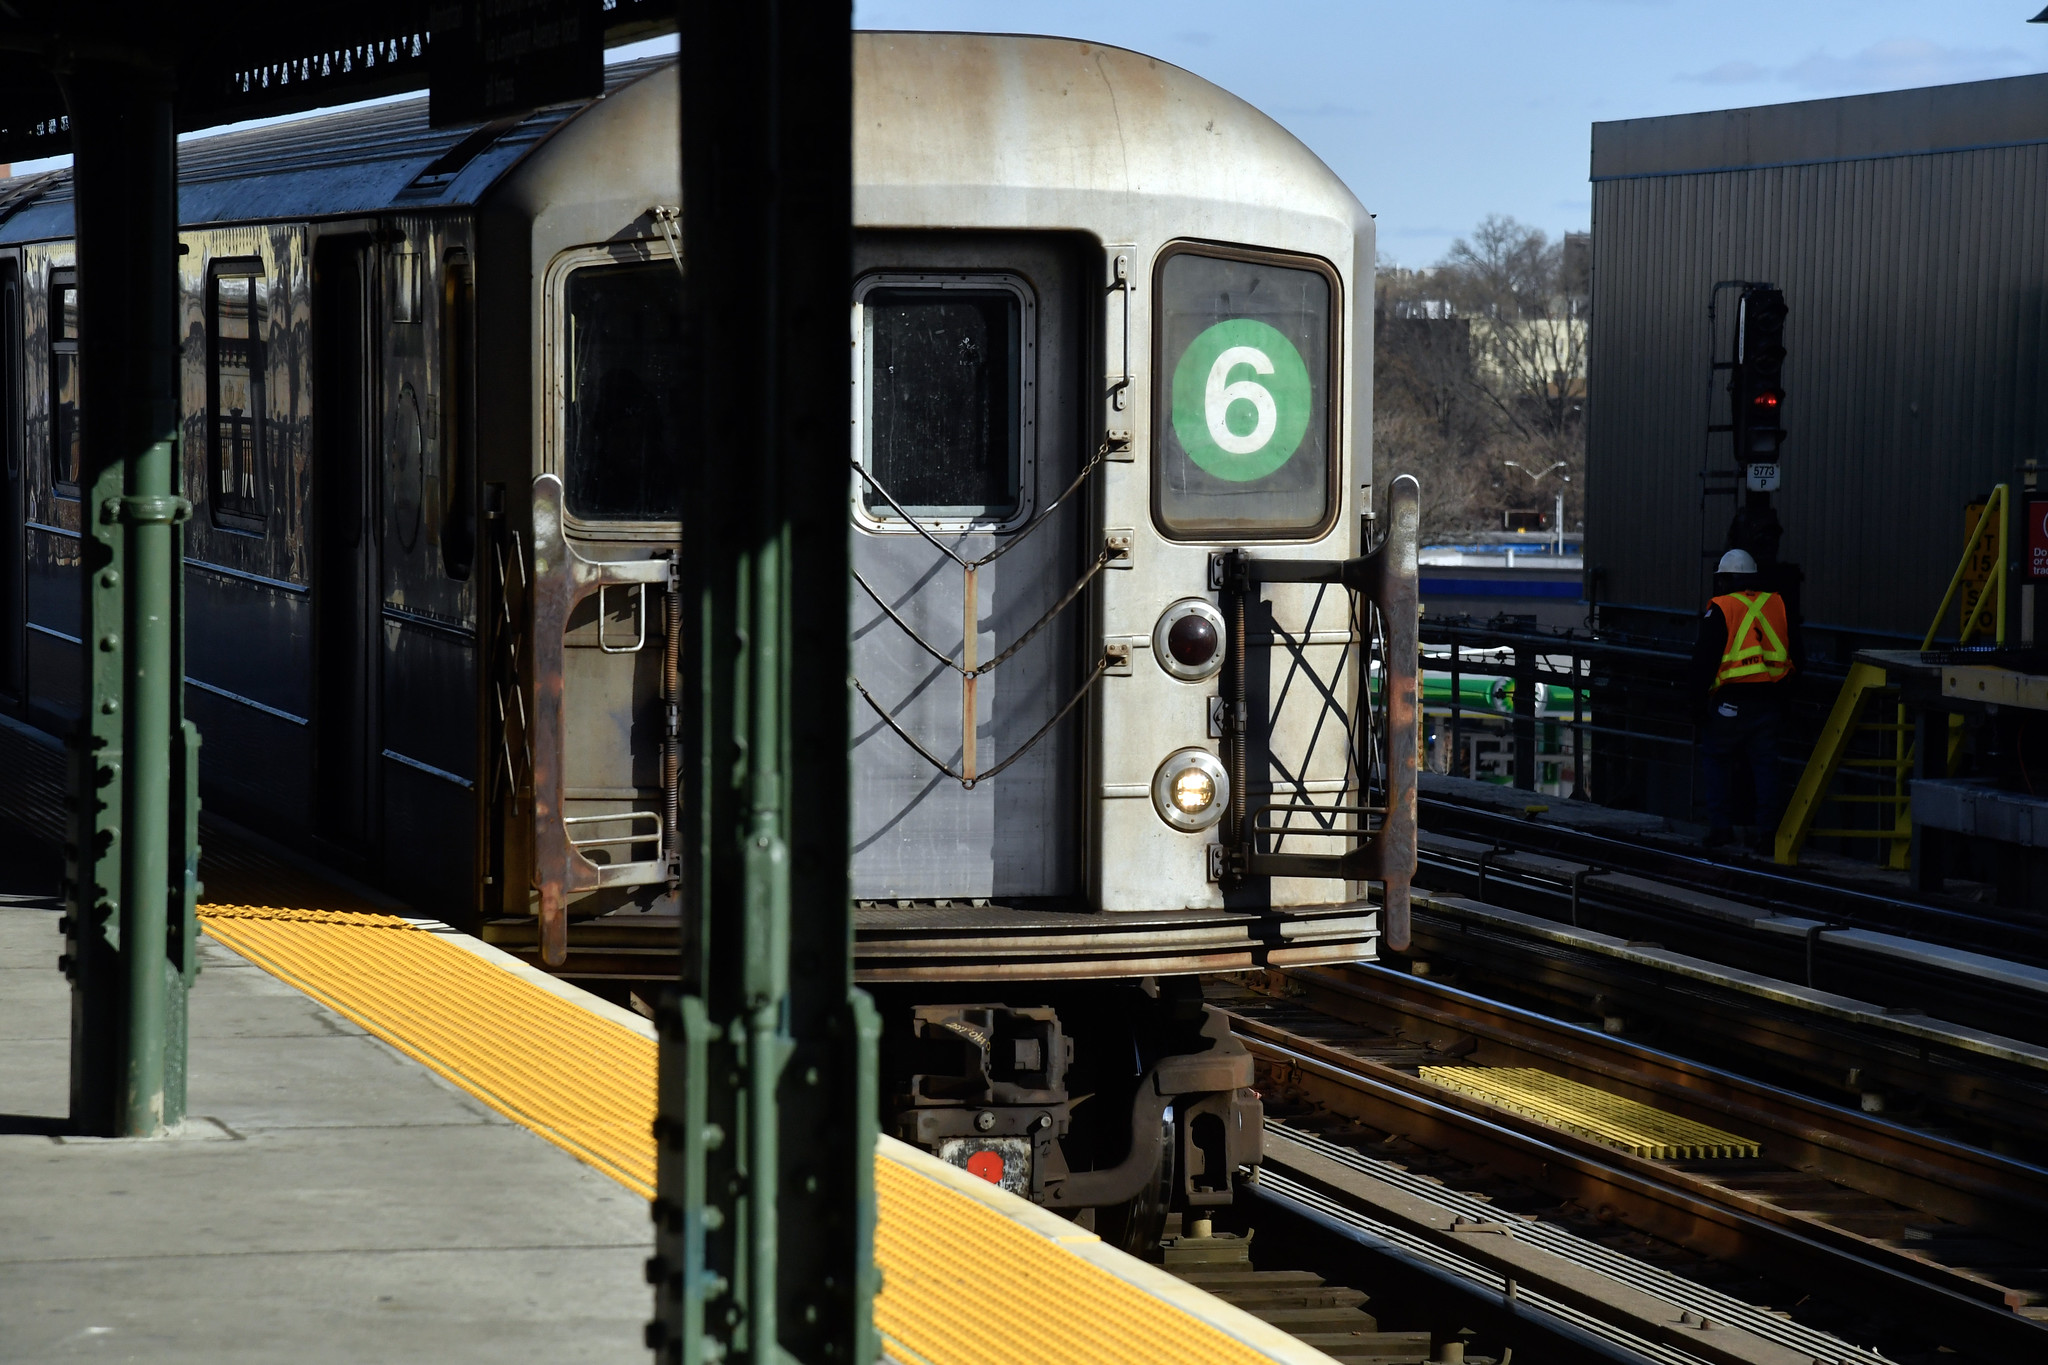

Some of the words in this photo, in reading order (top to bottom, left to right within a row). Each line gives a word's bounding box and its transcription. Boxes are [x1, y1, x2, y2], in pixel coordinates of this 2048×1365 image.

[1204, 345, 1277, 455] 6
[1753, 466, 1775, 476] 5773
[1760, 479, 1767, 488] P
[2033, 547, 2047, 557] Do
[1973, 556, 1991, 571] 15
[1741, 656, 1759, 666] NYC
